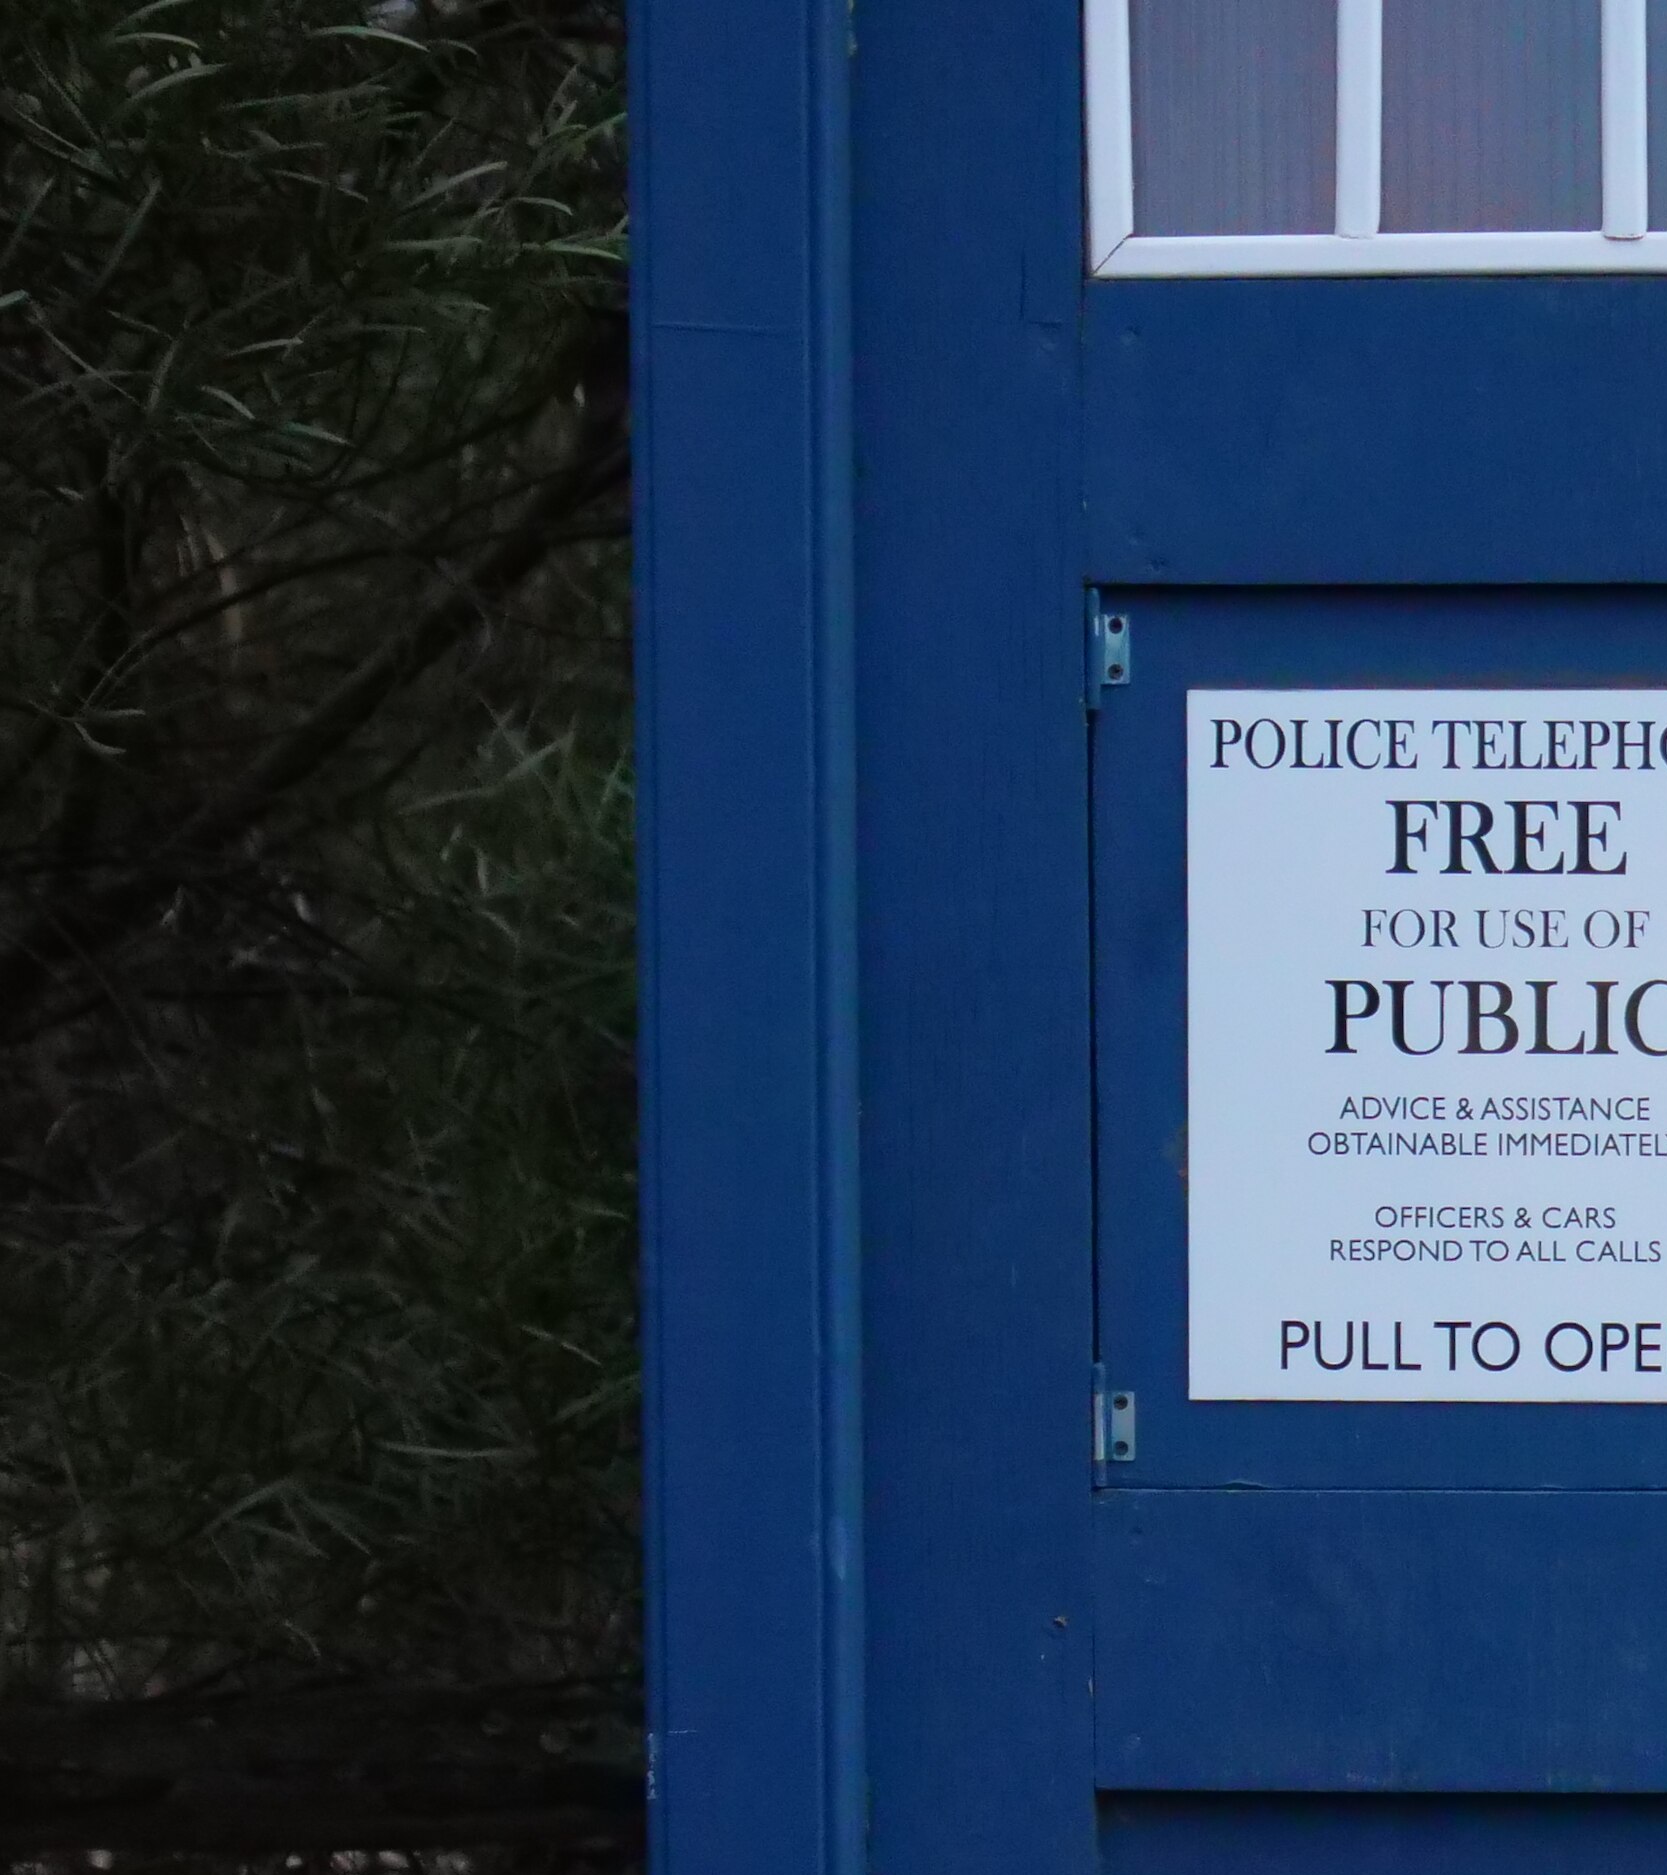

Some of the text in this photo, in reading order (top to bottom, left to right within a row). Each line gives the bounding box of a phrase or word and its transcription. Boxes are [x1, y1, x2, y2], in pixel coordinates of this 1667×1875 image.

[1210, 718, 1418, 769] POLICE
[1385, 800, 1627, 875] FREE
[1361, 909, 1651, 950] FOR USE OF
[1339, 1096, 1651, 1121] ADVICE & ASSISTANCE
[1308, 1131, 1488, 1157] OBTAINABLE
[1374, 1206, 1617, 1229] OFFICERS & CARS
[1330, 1239, 1662, 1263] RESPOND TO ALL CALLS
[1280, 1320, 1422, 1372] PULL
[1433, 1321, 1521, 1373] TO
